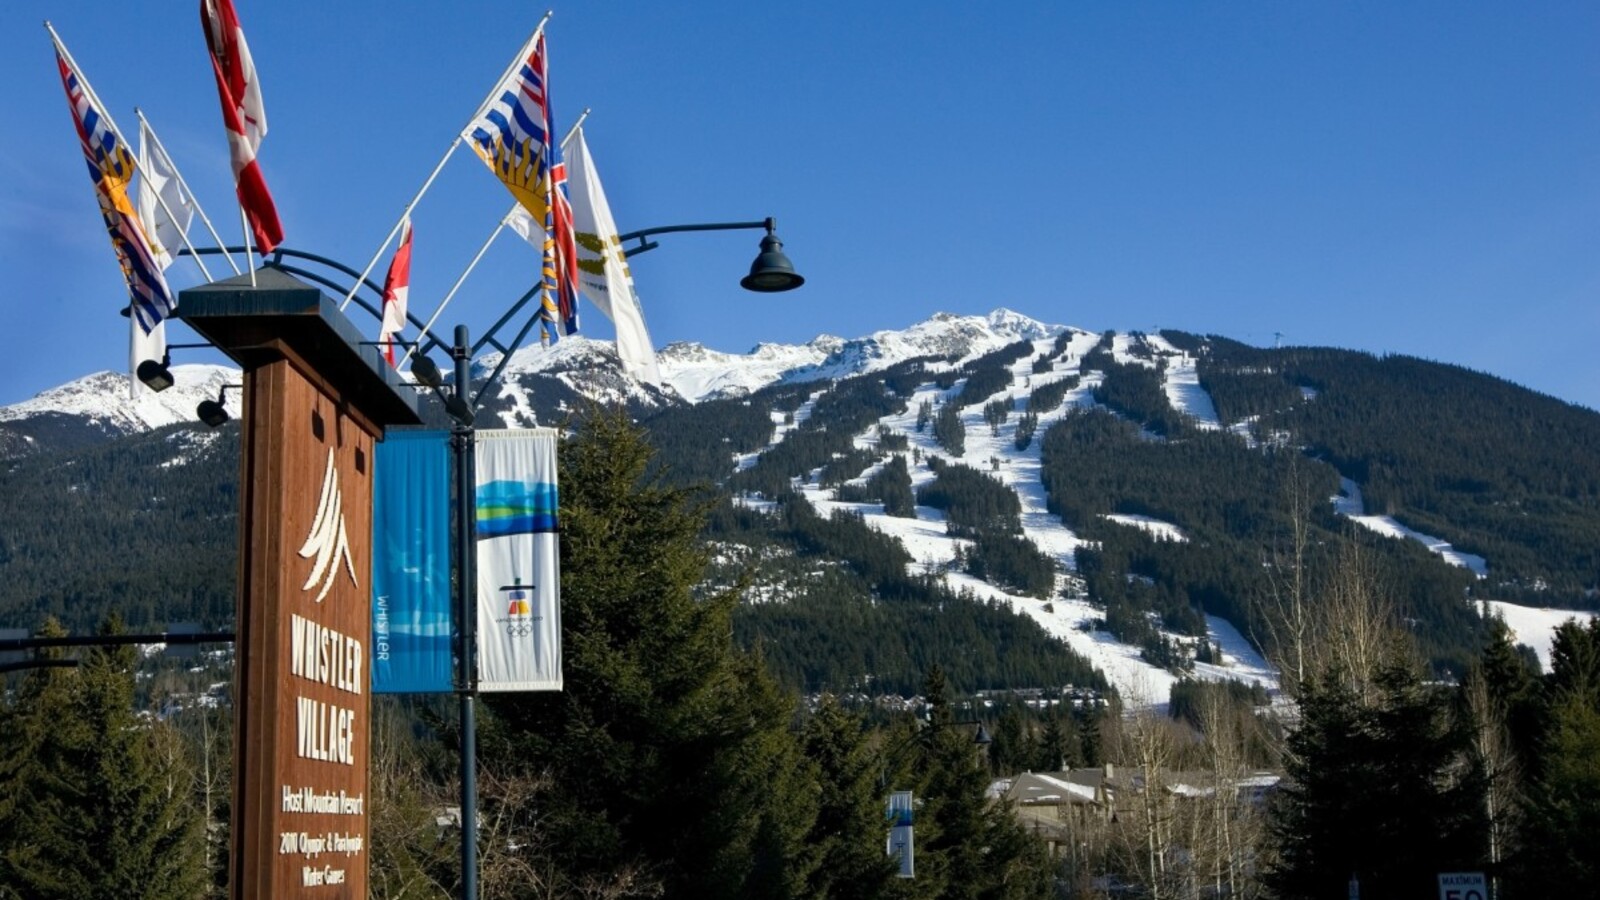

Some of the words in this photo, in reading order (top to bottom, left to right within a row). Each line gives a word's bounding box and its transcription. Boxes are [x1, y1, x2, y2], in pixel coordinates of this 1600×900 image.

[291, 613, 362, 695] WHISTLER
[297, 696, 355, 766] VILLAGE
[282, 785, 303, 813] Host
[304, 786, 339, 814] Mountain
[340, 789, 363, 816] Resort
[279, 832, 298, 855] 2010
[299, 832, 326, 860] Olympic
[326, 832, 333, 852] &
[302, 865, 323, 887] Winter
[324, 864, 345, 885] Games
[1442, 875, 1482, 885] MAXIMUM
